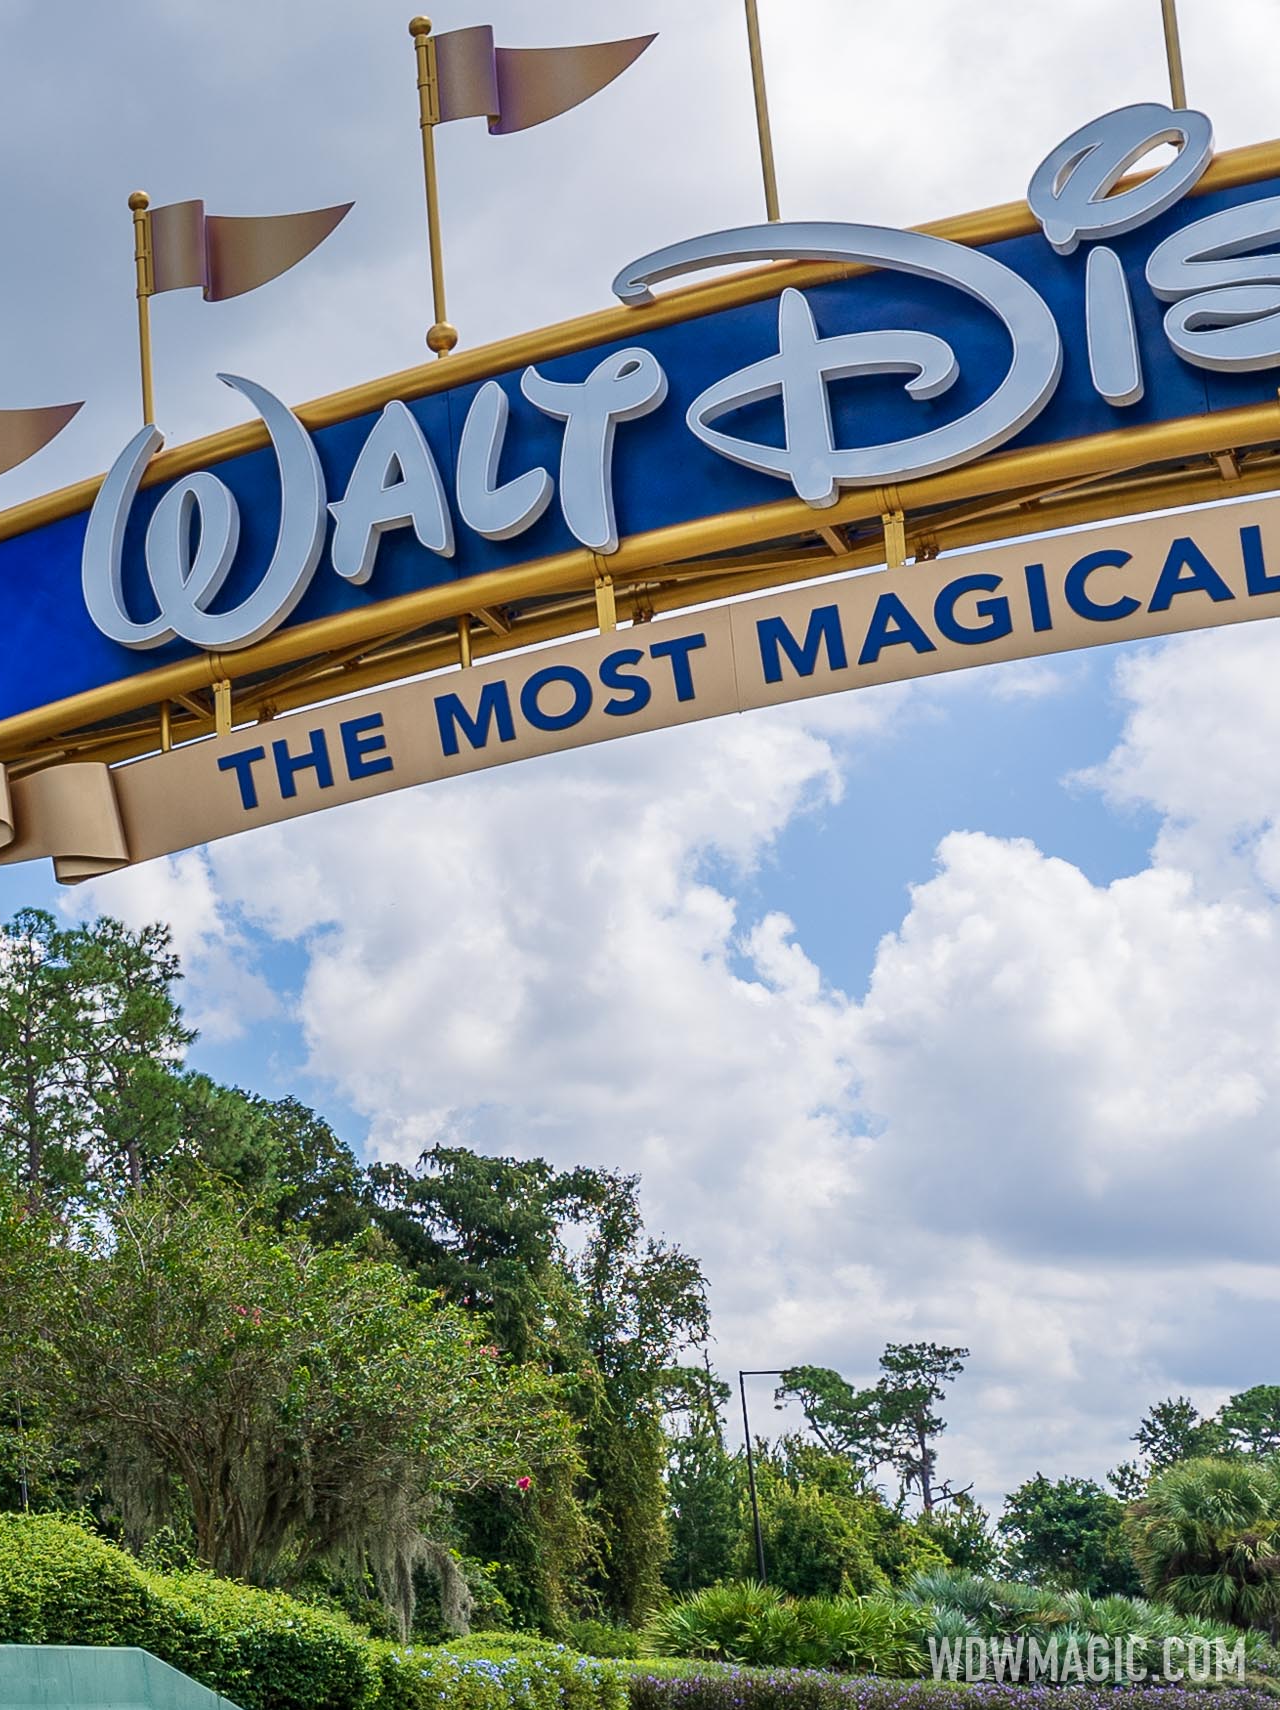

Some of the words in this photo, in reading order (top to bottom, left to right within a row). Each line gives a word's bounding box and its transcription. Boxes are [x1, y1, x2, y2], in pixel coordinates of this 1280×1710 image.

[217, 711, 394, 811] THE
[433, 632, 707, 757] MOST
[756, 524, 1280, 682] MAGICAL
